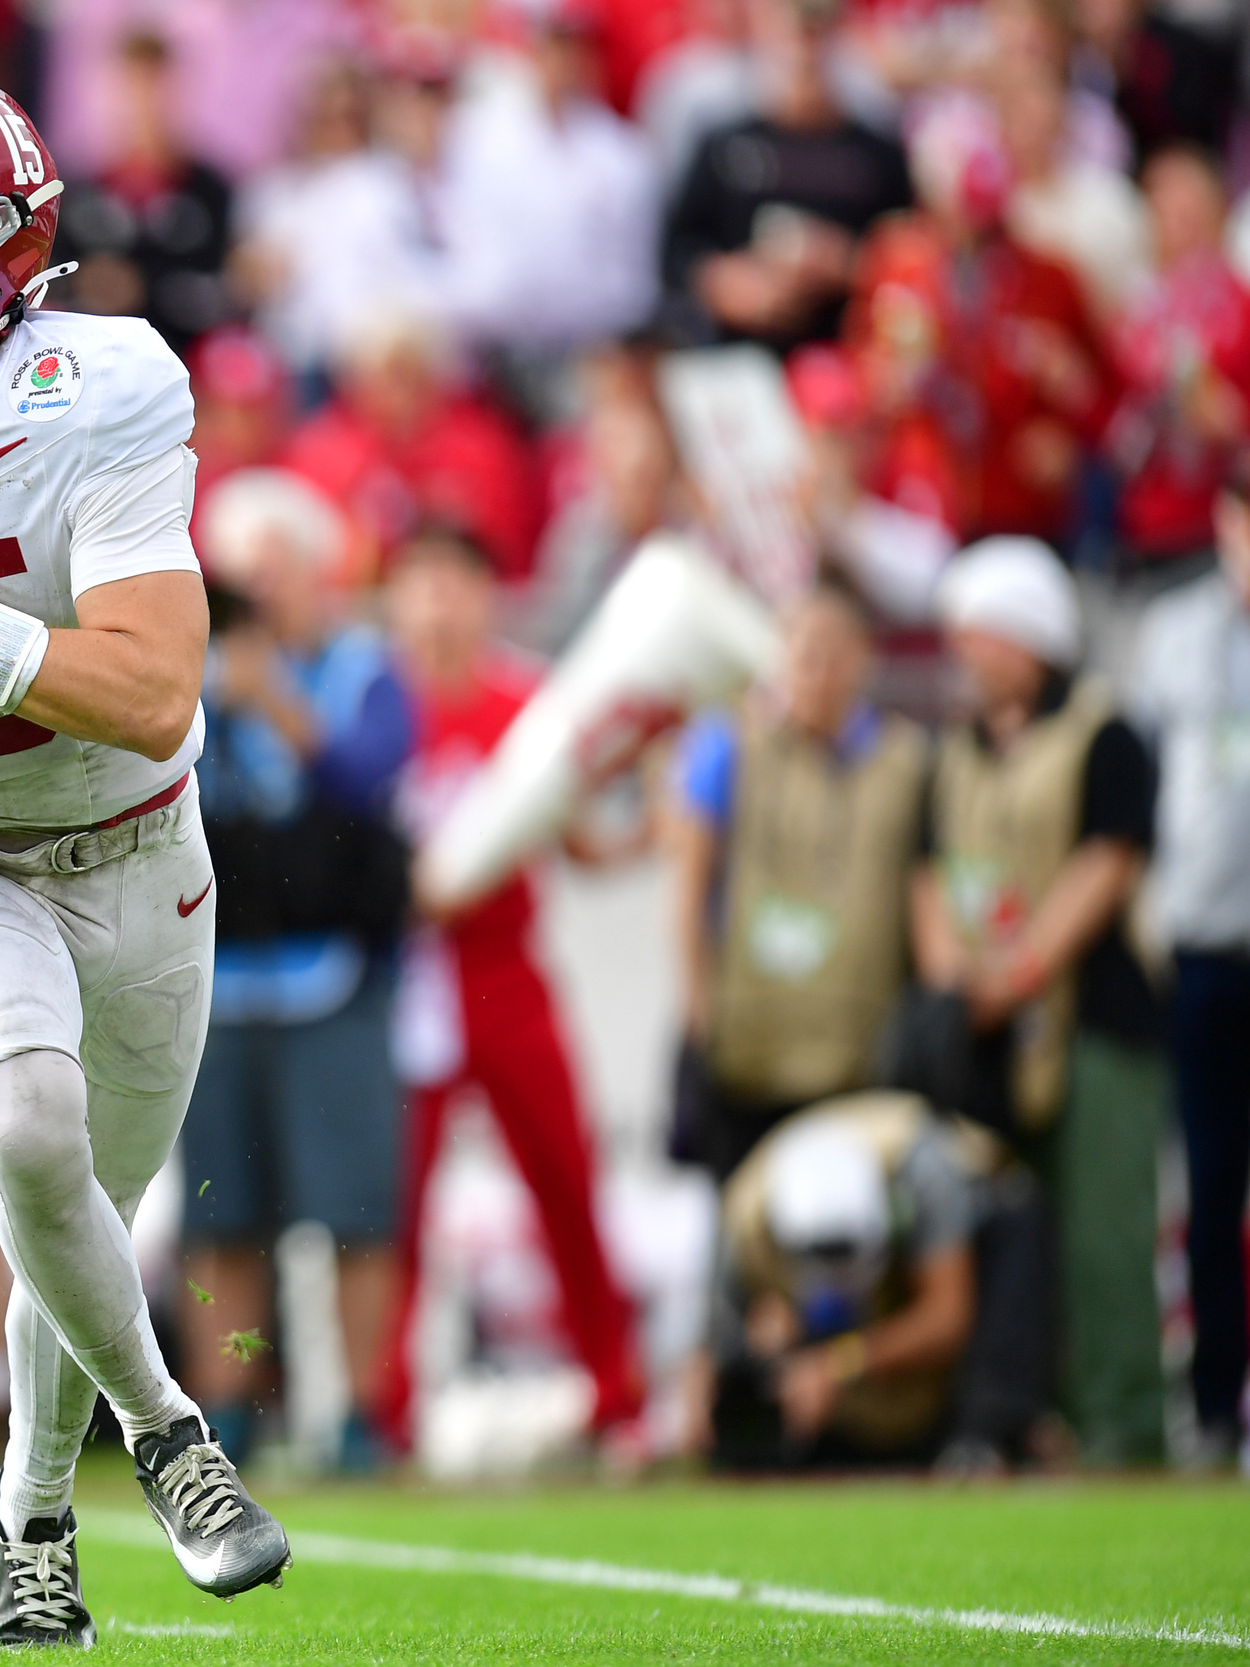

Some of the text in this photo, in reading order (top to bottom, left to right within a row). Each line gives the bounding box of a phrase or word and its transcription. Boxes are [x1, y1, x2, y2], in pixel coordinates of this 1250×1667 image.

[11, 346, 81, 390] ROSE BOWL GAME
[31, 397, 71, 410] Prudential
